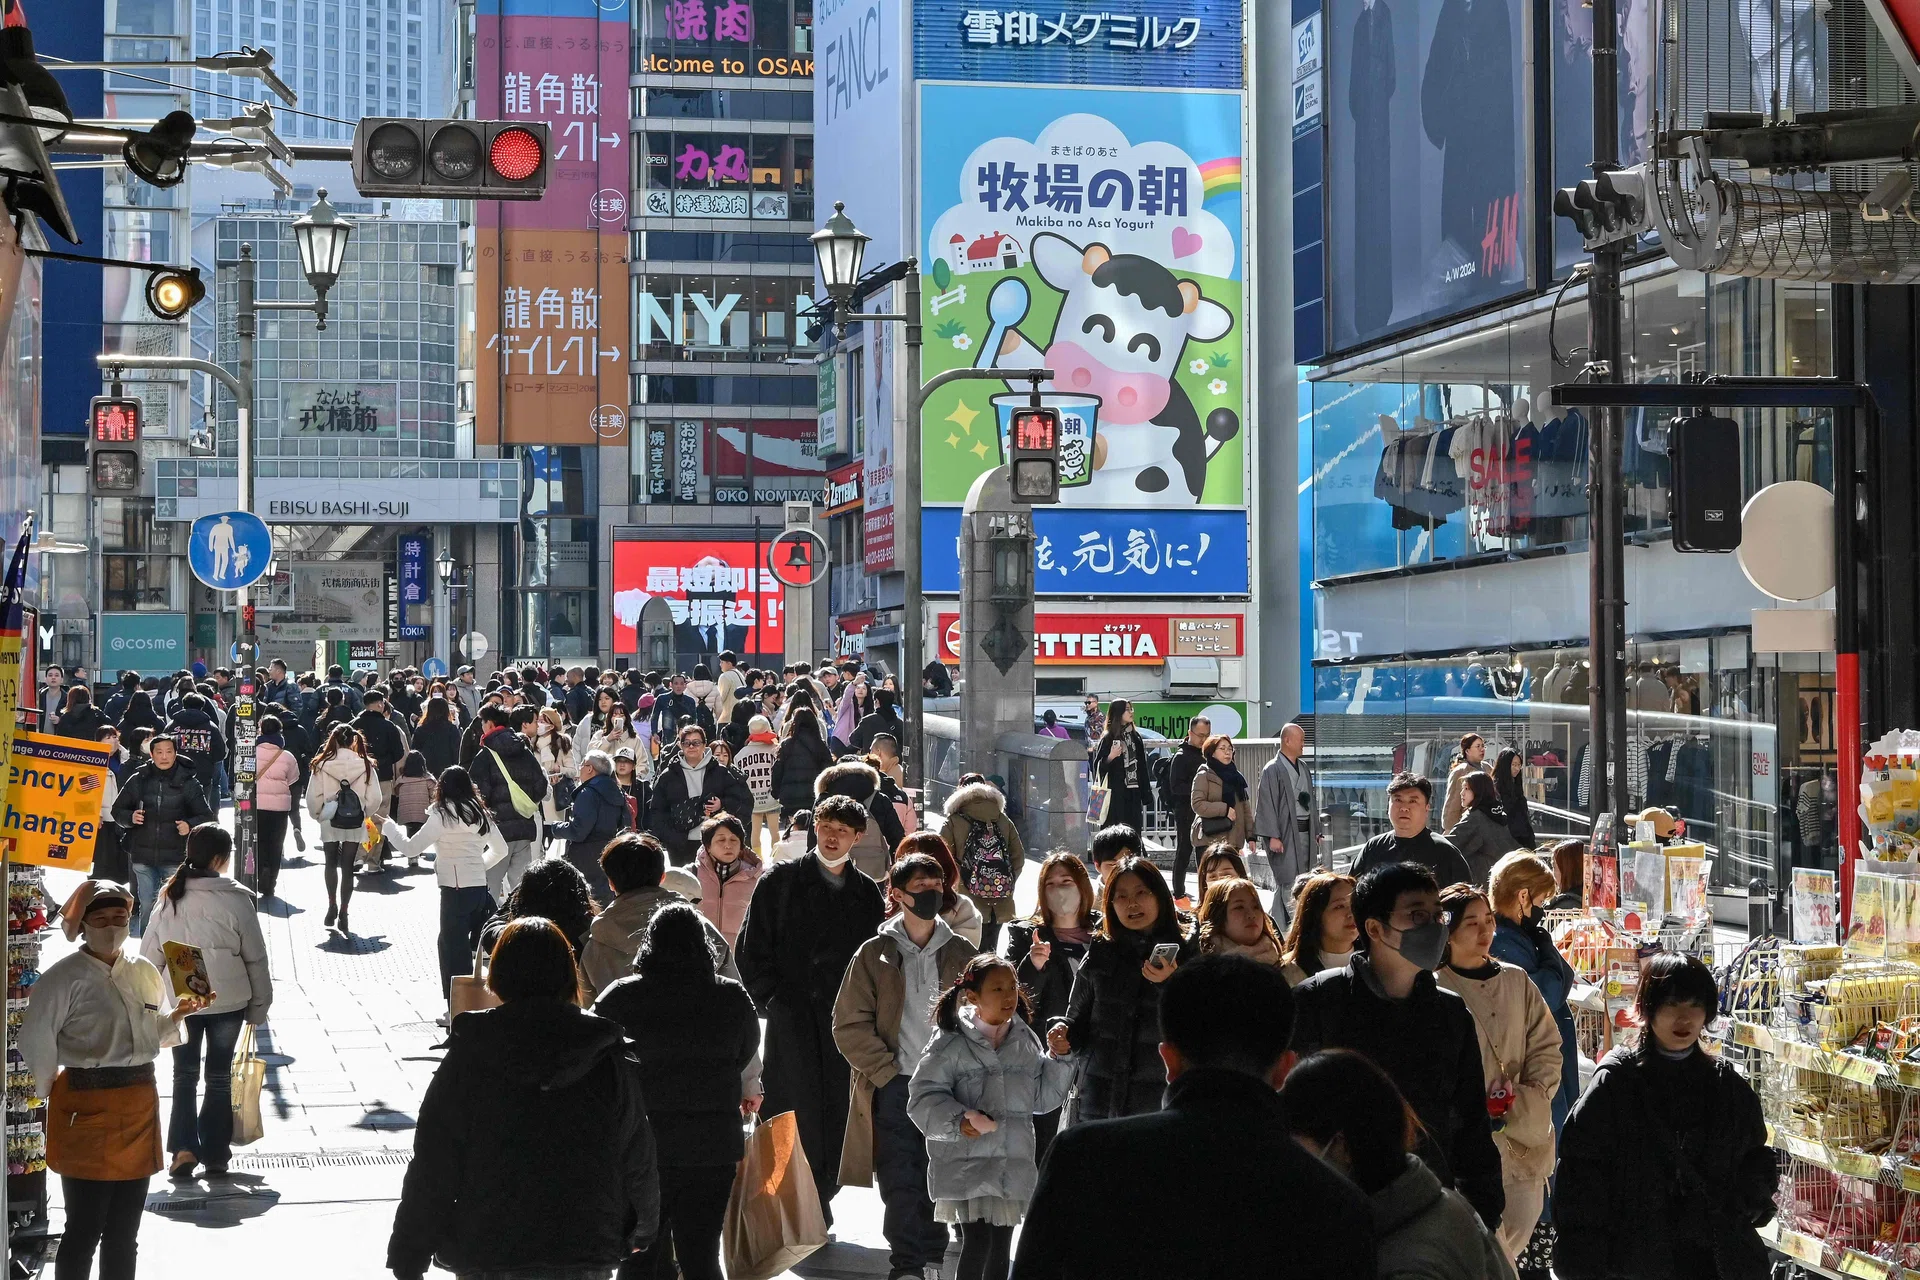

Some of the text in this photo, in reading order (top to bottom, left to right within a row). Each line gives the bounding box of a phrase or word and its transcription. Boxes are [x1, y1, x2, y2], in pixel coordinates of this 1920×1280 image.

[665, 0, 755, 42] 焼肉
[963, 10, 1200, 48] 雪印メグミルク
[641, 54, 813, 75] elcome to OSAK
[826, 1, 888, 125] FANCL
[505, 72, 602, 116] 龍角散
[646, 156, 667, 164] OPEN
[1051, 145, 1118, 158] まきばのあさ
[978, 161, 1188, 217] 牧場の朝
[593, 200, 623, 212] 生薬
[676, 195, 747, 214] 特選焼肉
[1016, 216, 1154, 231] Makiba no Asa Yogurt
[1481, 191, 1519, 278] H&M
[1460, 261, 1476, 278] 2024
[504, 286, 602, 330] 龍角散
[639, 293, 742, 345] NY
[315, 389, 361, 405] なんば
[505, 383, 544, 393] トローチ
[300, 405, 378, 432] 戎橋筋
[593, 414, 622, 428] 生薬
[650, 431, 665, 495] 焼きそば
[680, 422, 696, 500] お好み焼き
[1470, 438, 1532, 490] SALE
[270, 501, 317, 515] EBISU
[1036, 528, 1211, 576] を、元気に!
[405, 541, 421, 600] 時計倉
[646, 567, 779, 592] 最短即日
[322, 577, 379, 588] 戎橋筋商店街
[401, 627, 425, 635] TOKIA
[1104, 624, 1141, 632] ゼッテリア
[1179, 622, 1230, 631] 絶品バーガー
[111, 637, 177, 650] @cosme
[1035, 634, 1158, 656] TTERIA
[1196, 643, 1230, 651] コーヒー
[53, 751, 107, 765] COMMISSION
[1753, 753, 1770, 764] FINAL
[1863, 754, 1914, 771] WEL
[1753, 765, 1769, 776] SALE
[9, 765, 74, 797] ency
[4, 804, 94, 844] hange
